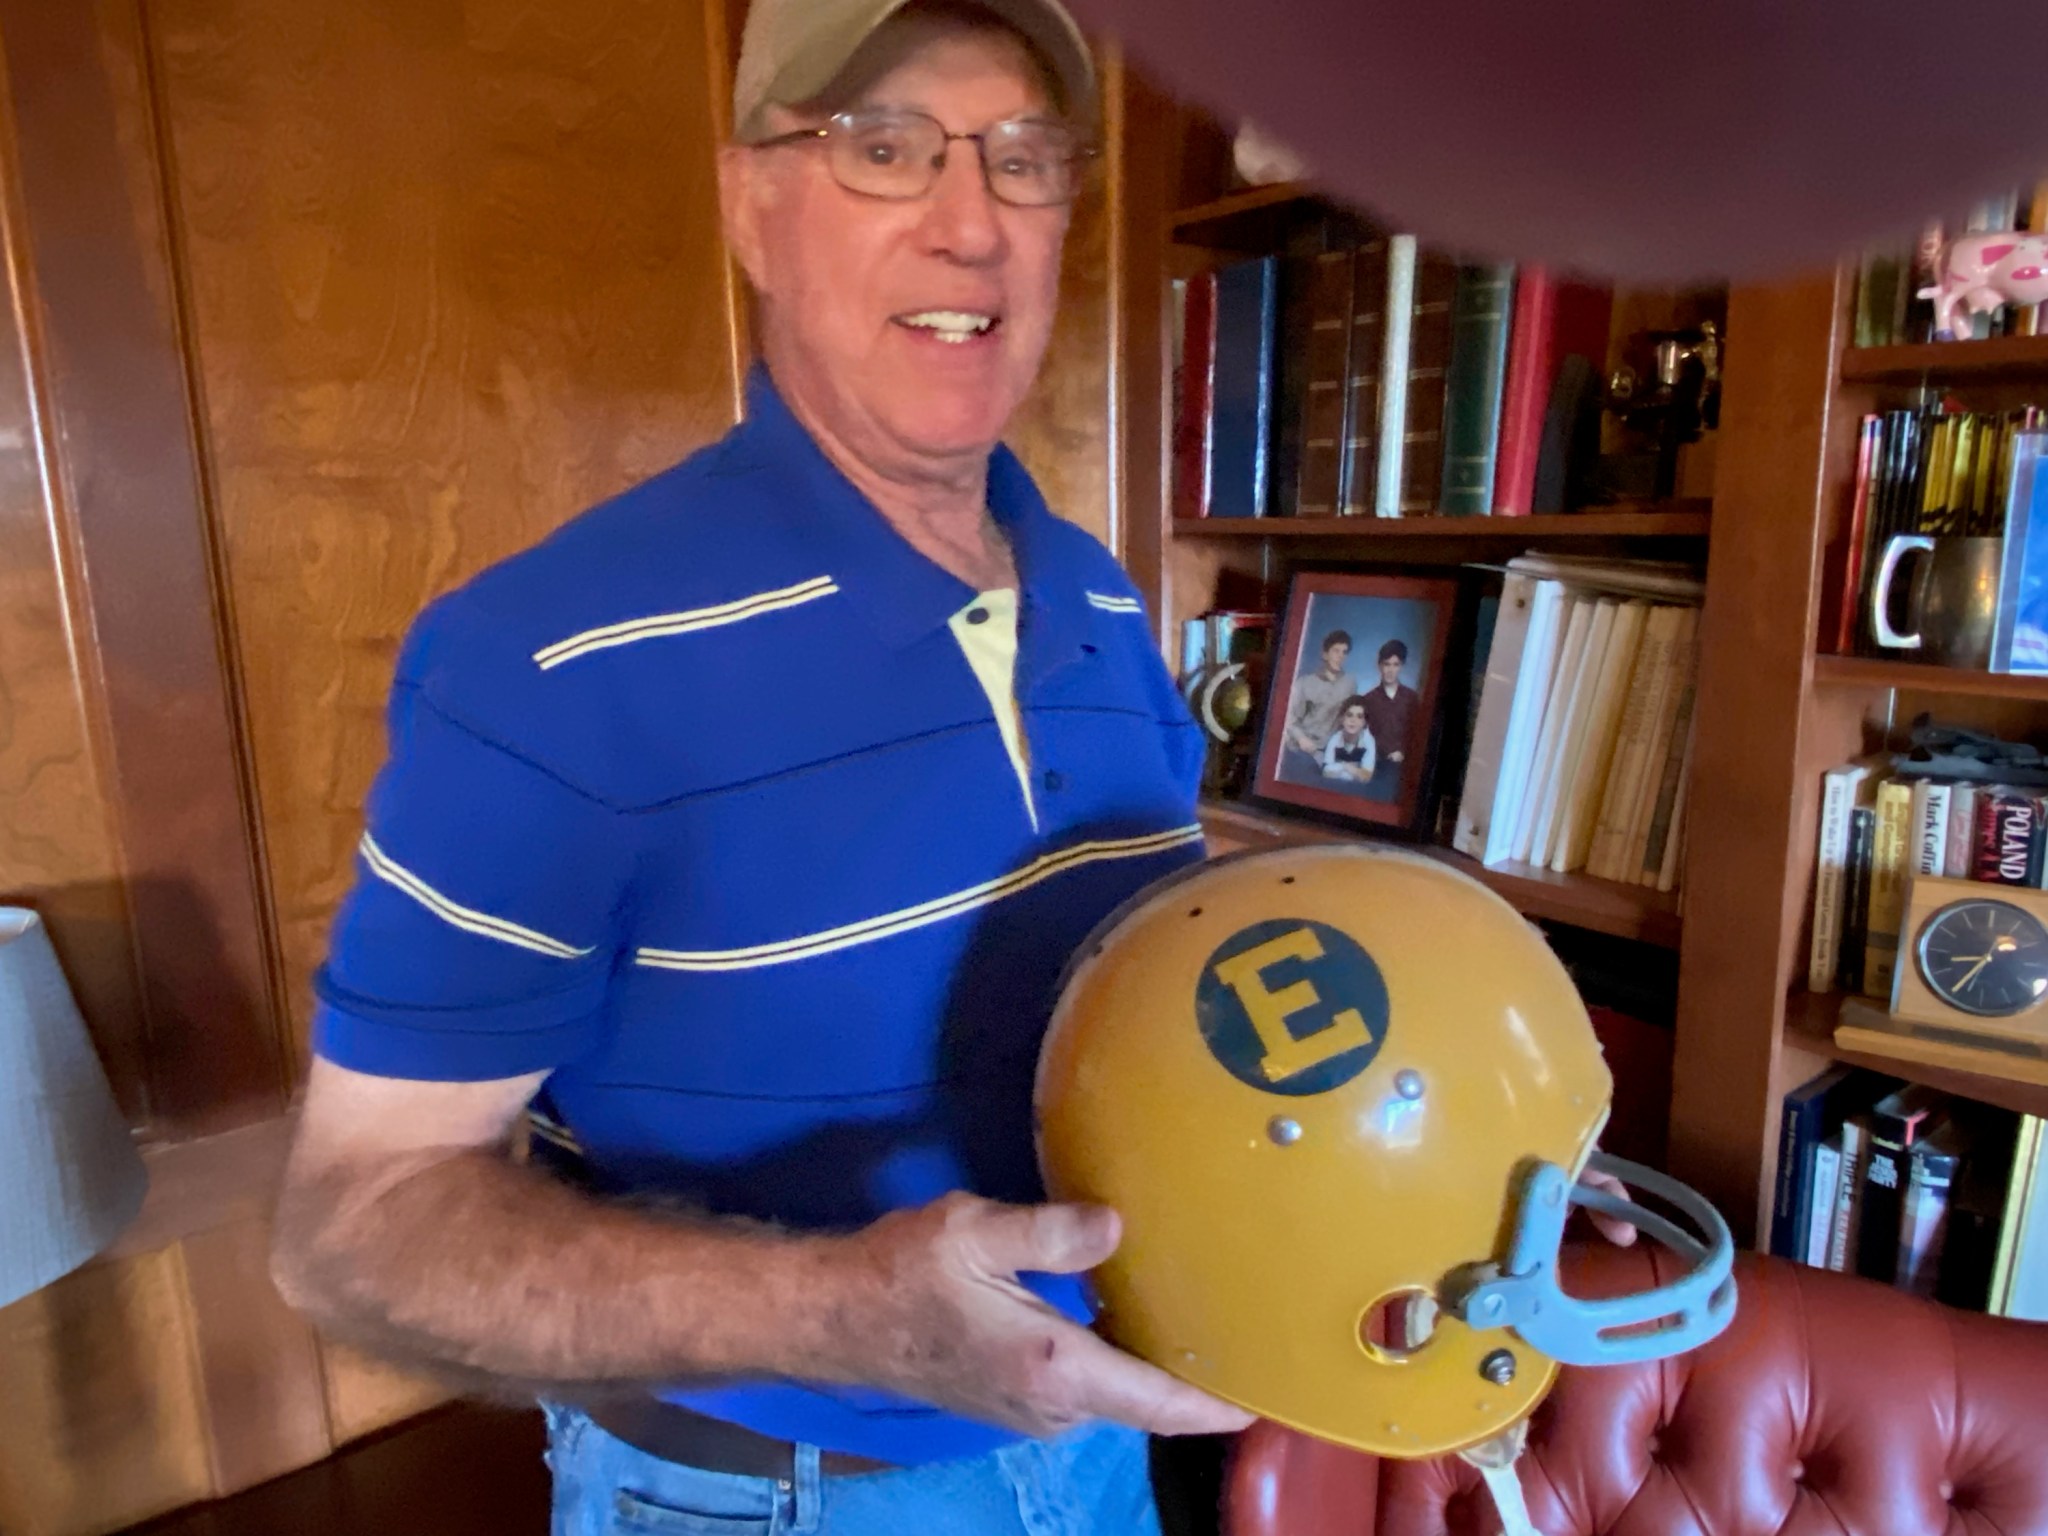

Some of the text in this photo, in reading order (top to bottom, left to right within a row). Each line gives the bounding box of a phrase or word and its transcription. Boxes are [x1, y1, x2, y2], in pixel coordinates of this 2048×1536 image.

[1921, 795, 1942, 874] Mark Coffin
[1999, 805, 2032, 880] POLAND
[1214, 927, 1373, 1083] E
[1842, 1153, 1859, 1201] TRIPLE
